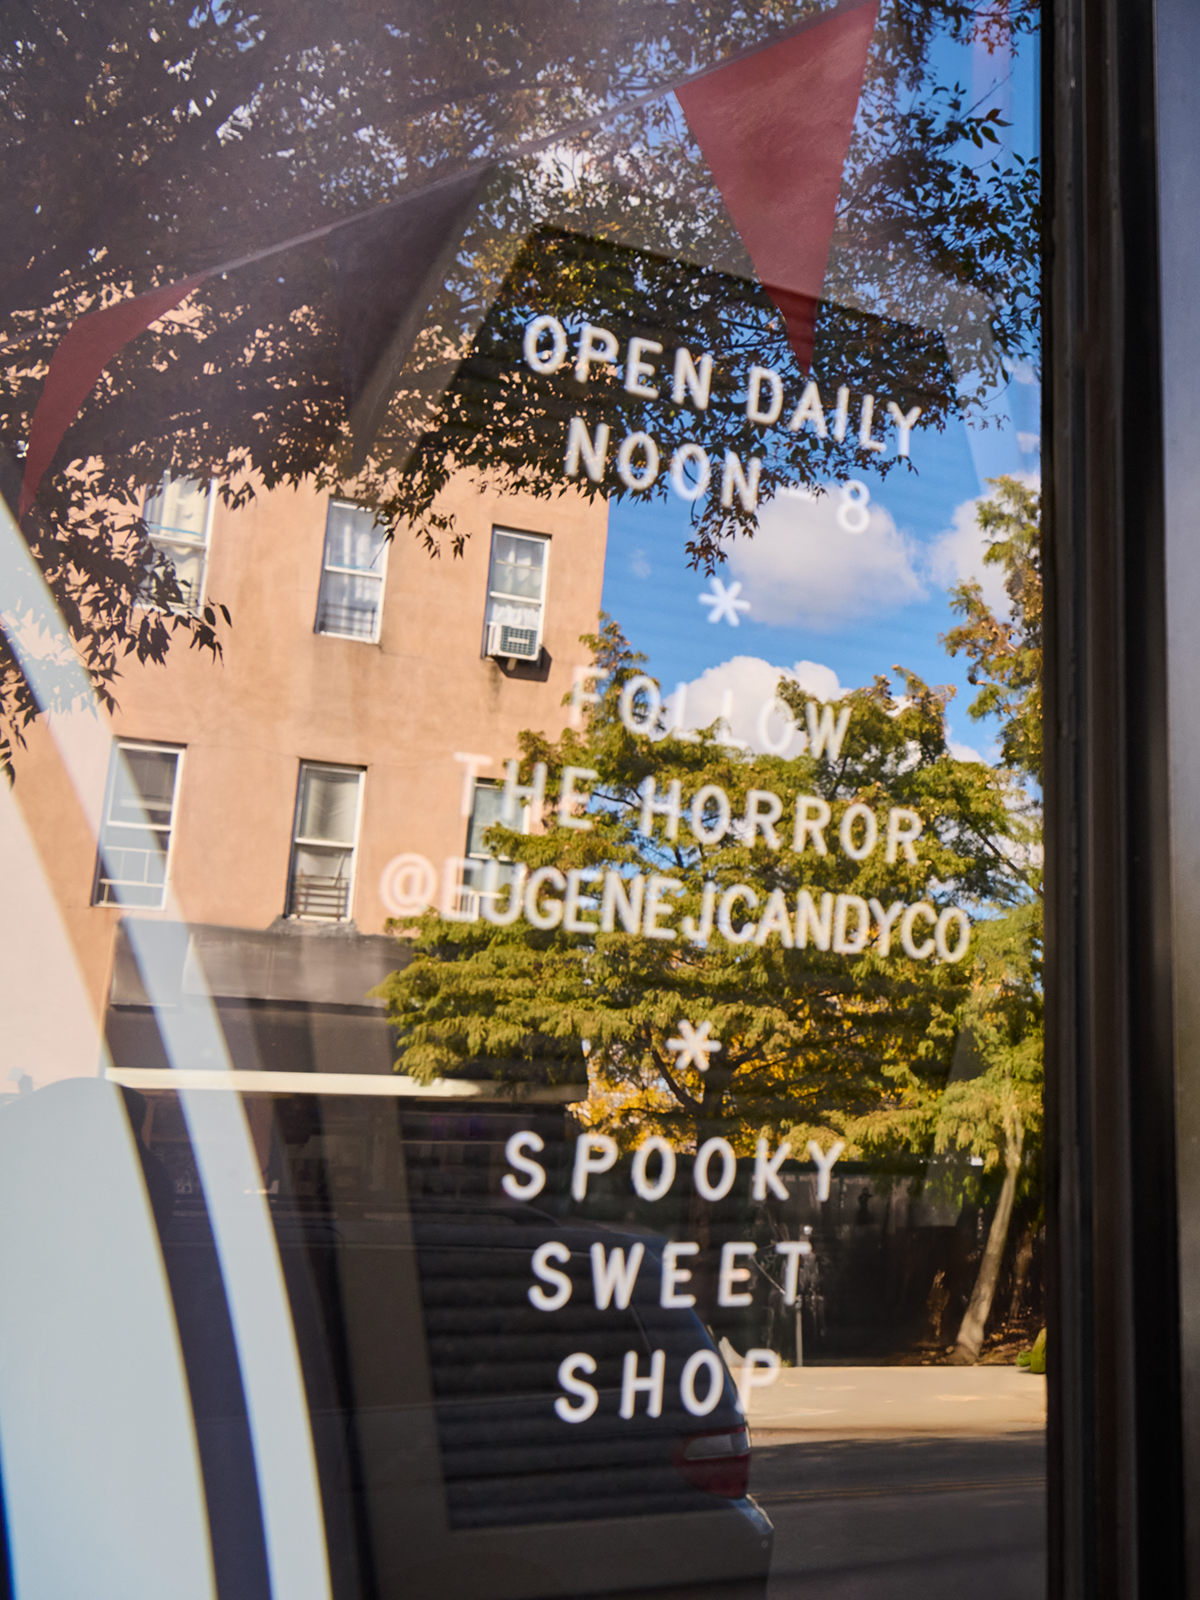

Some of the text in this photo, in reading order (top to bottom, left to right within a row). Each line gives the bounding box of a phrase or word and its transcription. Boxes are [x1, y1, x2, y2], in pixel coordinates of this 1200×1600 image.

[523, 315, 922, 457] OPEN DAILY
[565, 417, 763, 514] NOON
[836, 480, 871, 534] 8
[569, 665, 852, 763] FOLLOW
[454, 752, 923, 866] THE HORROR
[379, 851, 972, 964] @EUGENEJCANDYCO
[501, 1130, 846, 1202] SPOOKY
[527, 1241, 813, 1312] SWEET
[554, 1347, 782, 1424] SHOP
